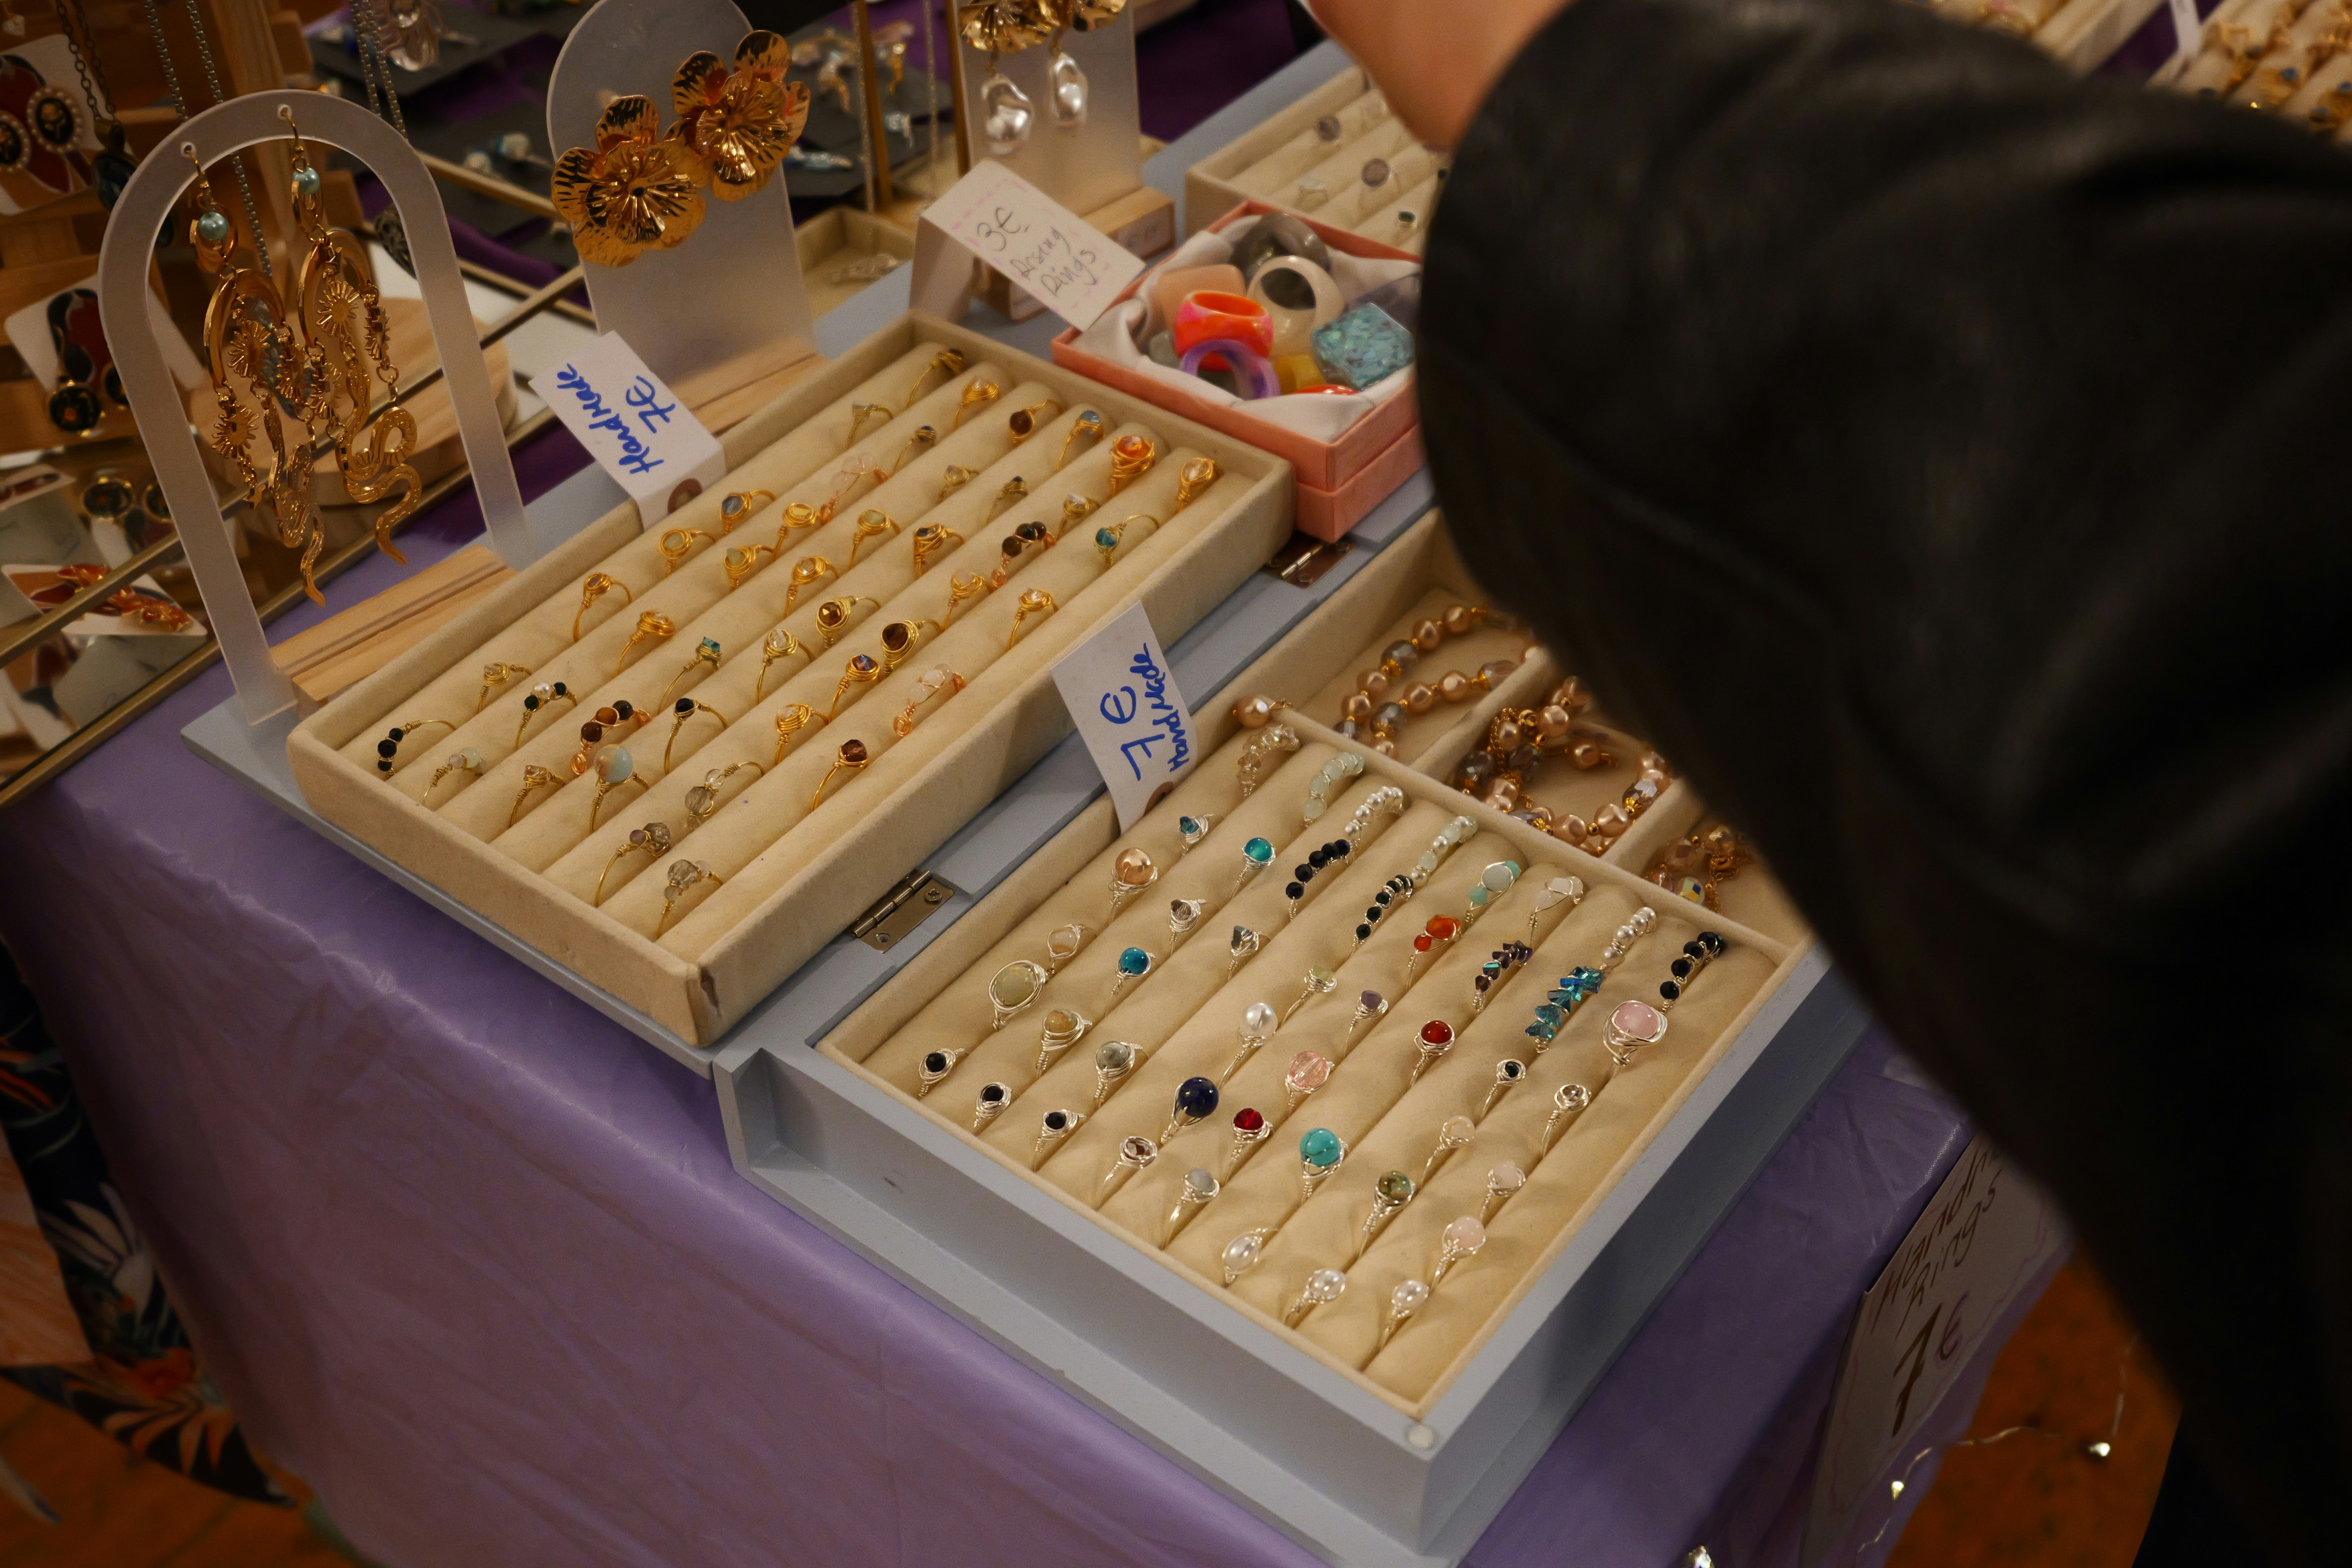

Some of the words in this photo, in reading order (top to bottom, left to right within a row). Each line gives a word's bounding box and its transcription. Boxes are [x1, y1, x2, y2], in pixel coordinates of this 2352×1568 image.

[1040, 249, 1098, 298] Rings
[626, 375, 676, 434] 7€
[1894, 1167, 2003, 1341] Rings
